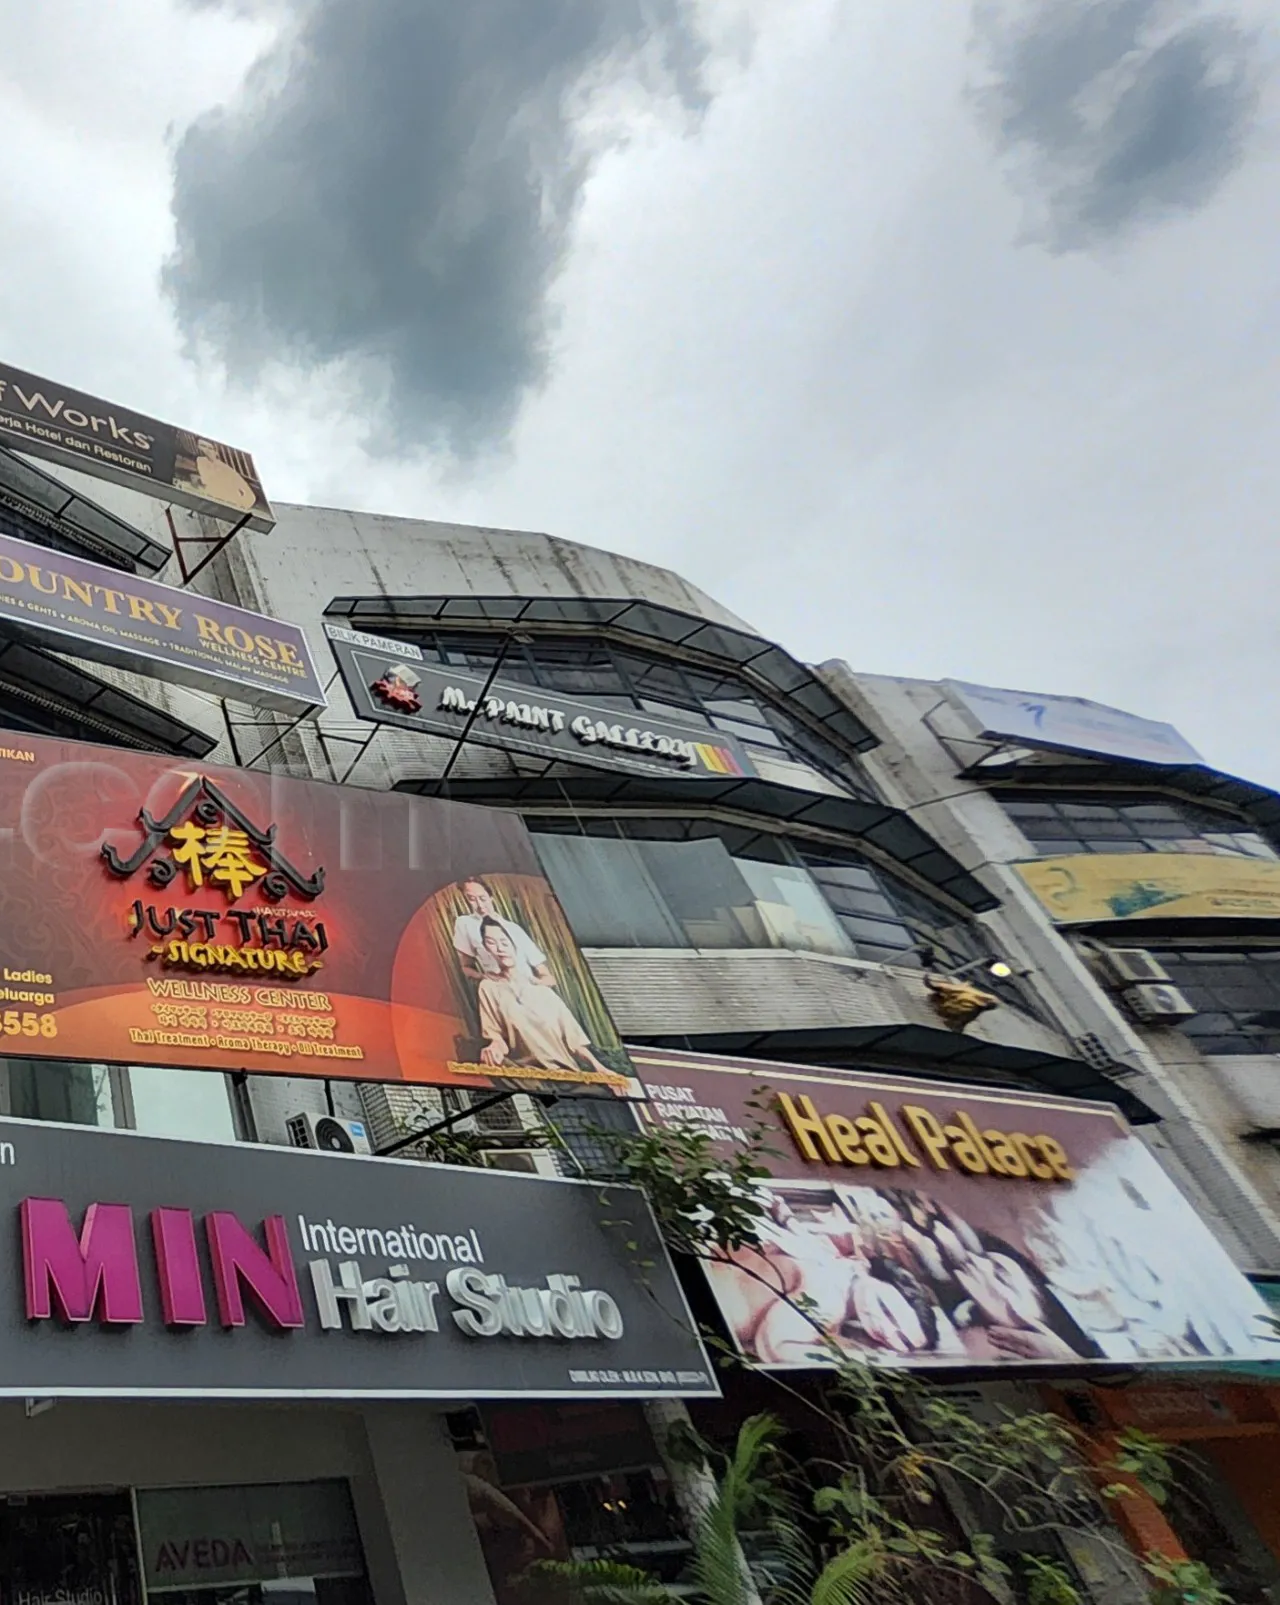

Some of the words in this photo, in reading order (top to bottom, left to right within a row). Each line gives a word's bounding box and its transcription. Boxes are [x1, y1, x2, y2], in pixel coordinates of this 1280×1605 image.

[6, 384, 152, 451] Works
[25, 420, 62, 443] Hotel
[65, 434, 91, 452] dan
[93, 444, 153, 474] Restoran
[193, 613, 305, 669] ROSE
[198, 638, 262, 666] WELLNESS
[262, 659, 309, 679] CENTRE
[328, 627, 361, 645] BILIK
[362, 637, 420, 660] PAMERAN
[126, 899, 220, 941] JUST
[227, 908, 330, 952] THAI
[3, 968, 53, 985] Ladies
[146, 977, 252, 1004] WELLNESS
[254, 985, 333, 1012] CENTER
[777, 1091, 921, 1170] Heal
[903, 1103, 1078, 1184] Palace
[20, 1196, 305, 1329] MIN
[298, 1214, 485, 1264] International
[309, 1258, 440, 1334] Hair
[445, 1266, 624, 1340] Studio
[155, 1538, 255, 1573] AVEDA
